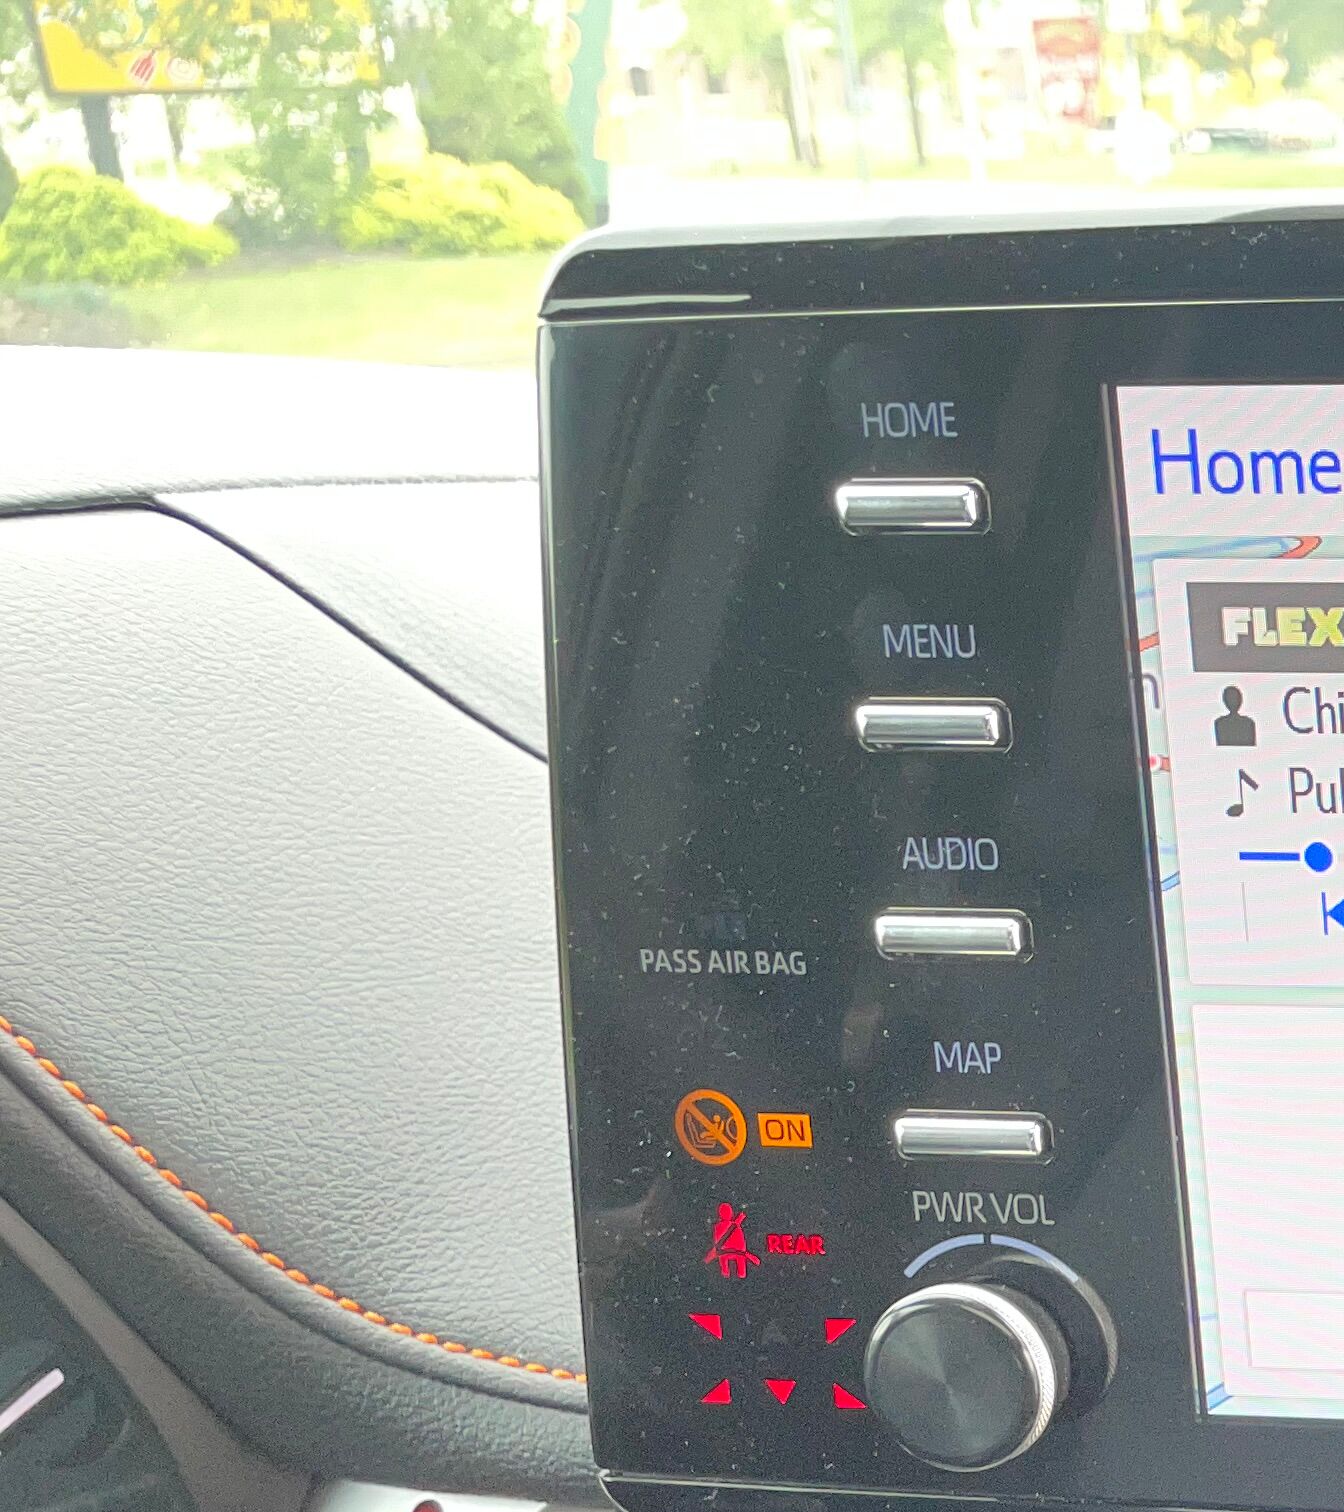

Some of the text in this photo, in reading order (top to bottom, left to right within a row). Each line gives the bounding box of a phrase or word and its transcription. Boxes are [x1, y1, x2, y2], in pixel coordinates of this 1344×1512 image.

[861, 402, 958, 439] HOME
[1150, 429, 1343, 496] Home
[883, 624, 977, 660] MENU
[902, 838, 999, 872] AUDIO
[640, 949, 807, 975] PASS AIR BAG
[934, 1042, 1001, 1074] MAP
[765, 1120, 805, 1142] ON
[912, 1191, 1055, 1226] PWR VOL
[767, 1234, 826, 1256] REAR
